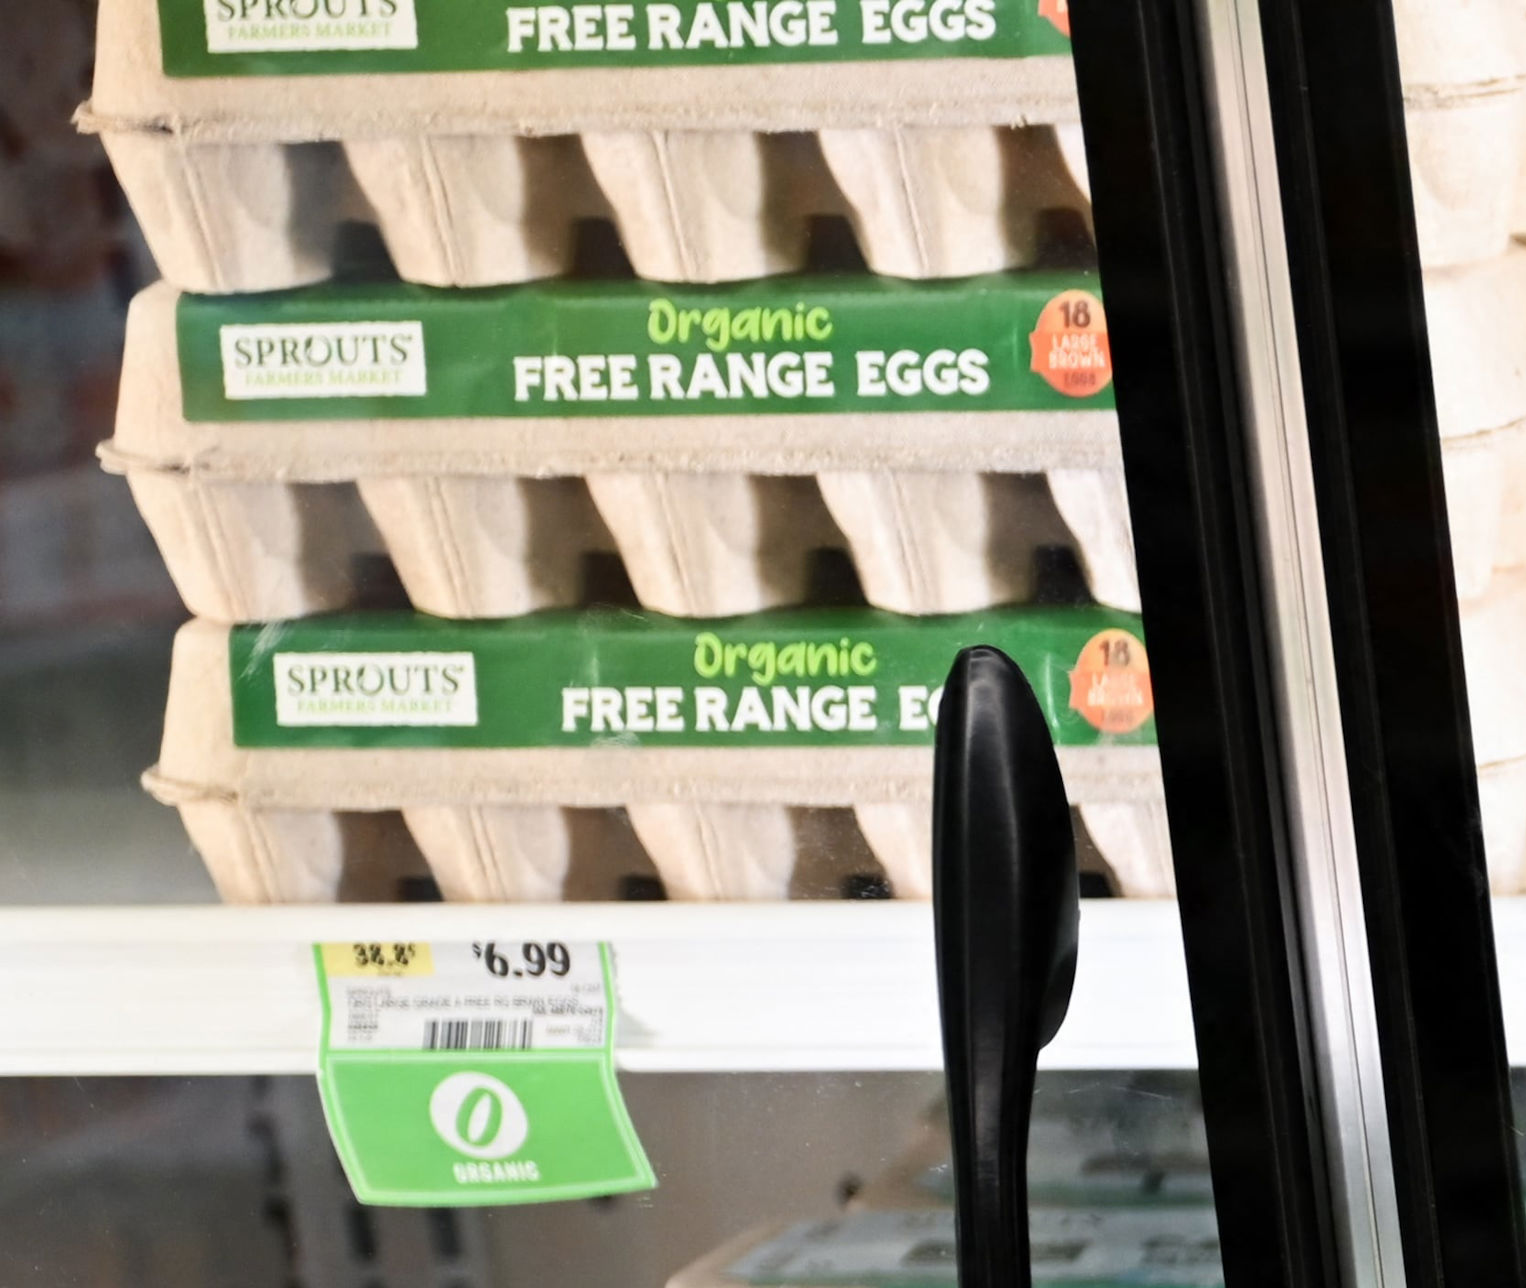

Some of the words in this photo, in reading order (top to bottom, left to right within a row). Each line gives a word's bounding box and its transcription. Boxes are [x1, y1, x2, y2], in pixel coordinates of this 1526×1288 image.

[507, 5, 637, 53] FREE
[646, 0, 839, 50] RANGE
[861, 0, 997, 43] EGGS
[647, 297, 834, 351] Organic
[1059, 300, 1092, 329] 18
[234, 333, 412, 368] SPROUTS
[513, 355, 638, 402] FREE
[650, 351, 834, 400] RANGE
[856, 348, 991, 397] EGGS
[694, 632, 877, 685] Organic
[1098, 639, 1131, 667] 18
[287, 664, 464, 698] SPROUTS
[561, 687, 685, 732] FREE
[694, 687, 878, 732] RANGE
[452, 1161, 541, 1184] ORGANIC
